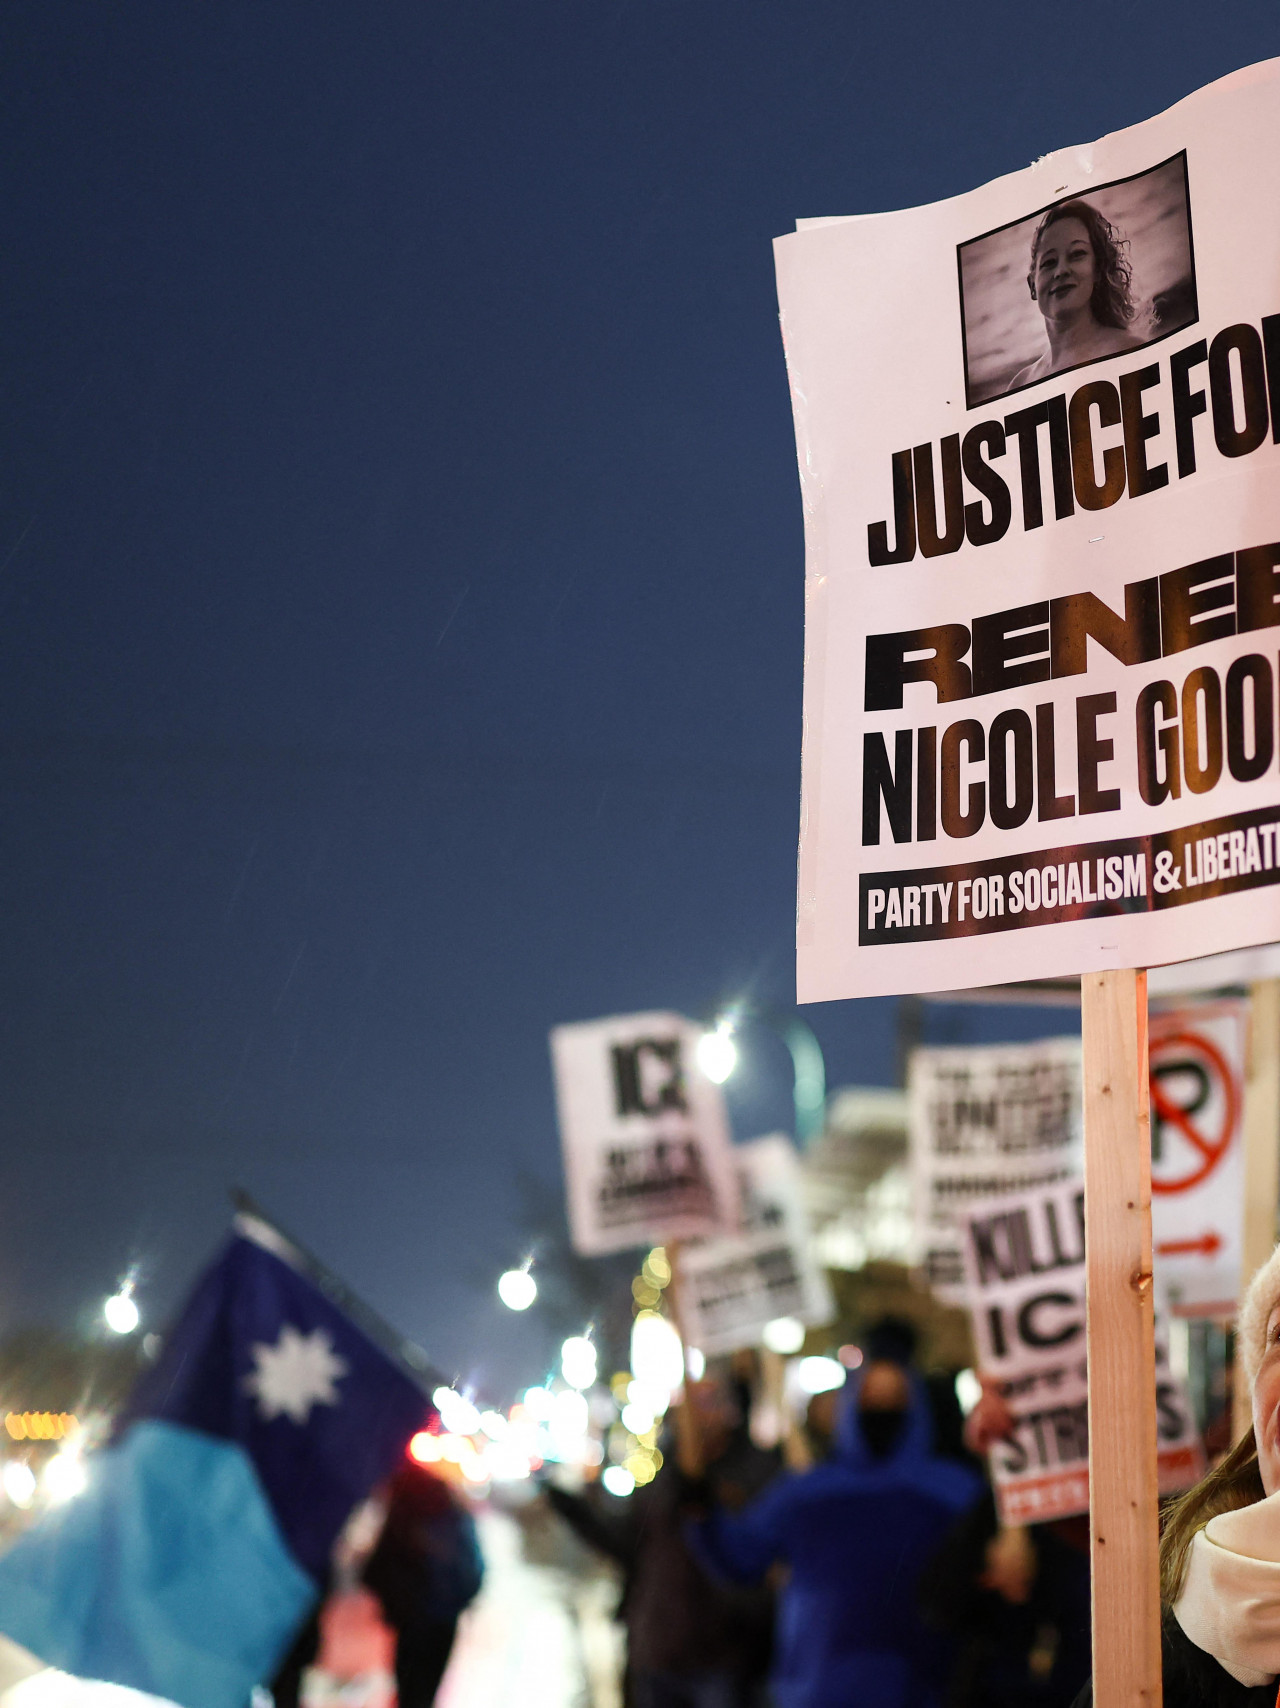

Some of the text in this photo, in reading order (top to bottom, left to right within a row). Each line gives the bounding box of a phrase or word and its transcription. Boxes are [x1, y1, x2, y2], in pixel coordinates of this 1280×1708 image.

[868, 362, 1169, 567] JUSTICE
[862, 691, 1121, 846] NICOLE
[867, 882, 953, 930] PARTY
[958, 874, 1004, 921] FOR
[1008, 853, 1147, 913] SOCIALISM
[1152, 849, 1183, 893] &
[970, 1190, 1087, 1286] KILL
[988, 1291, 1086, 1358] IC
